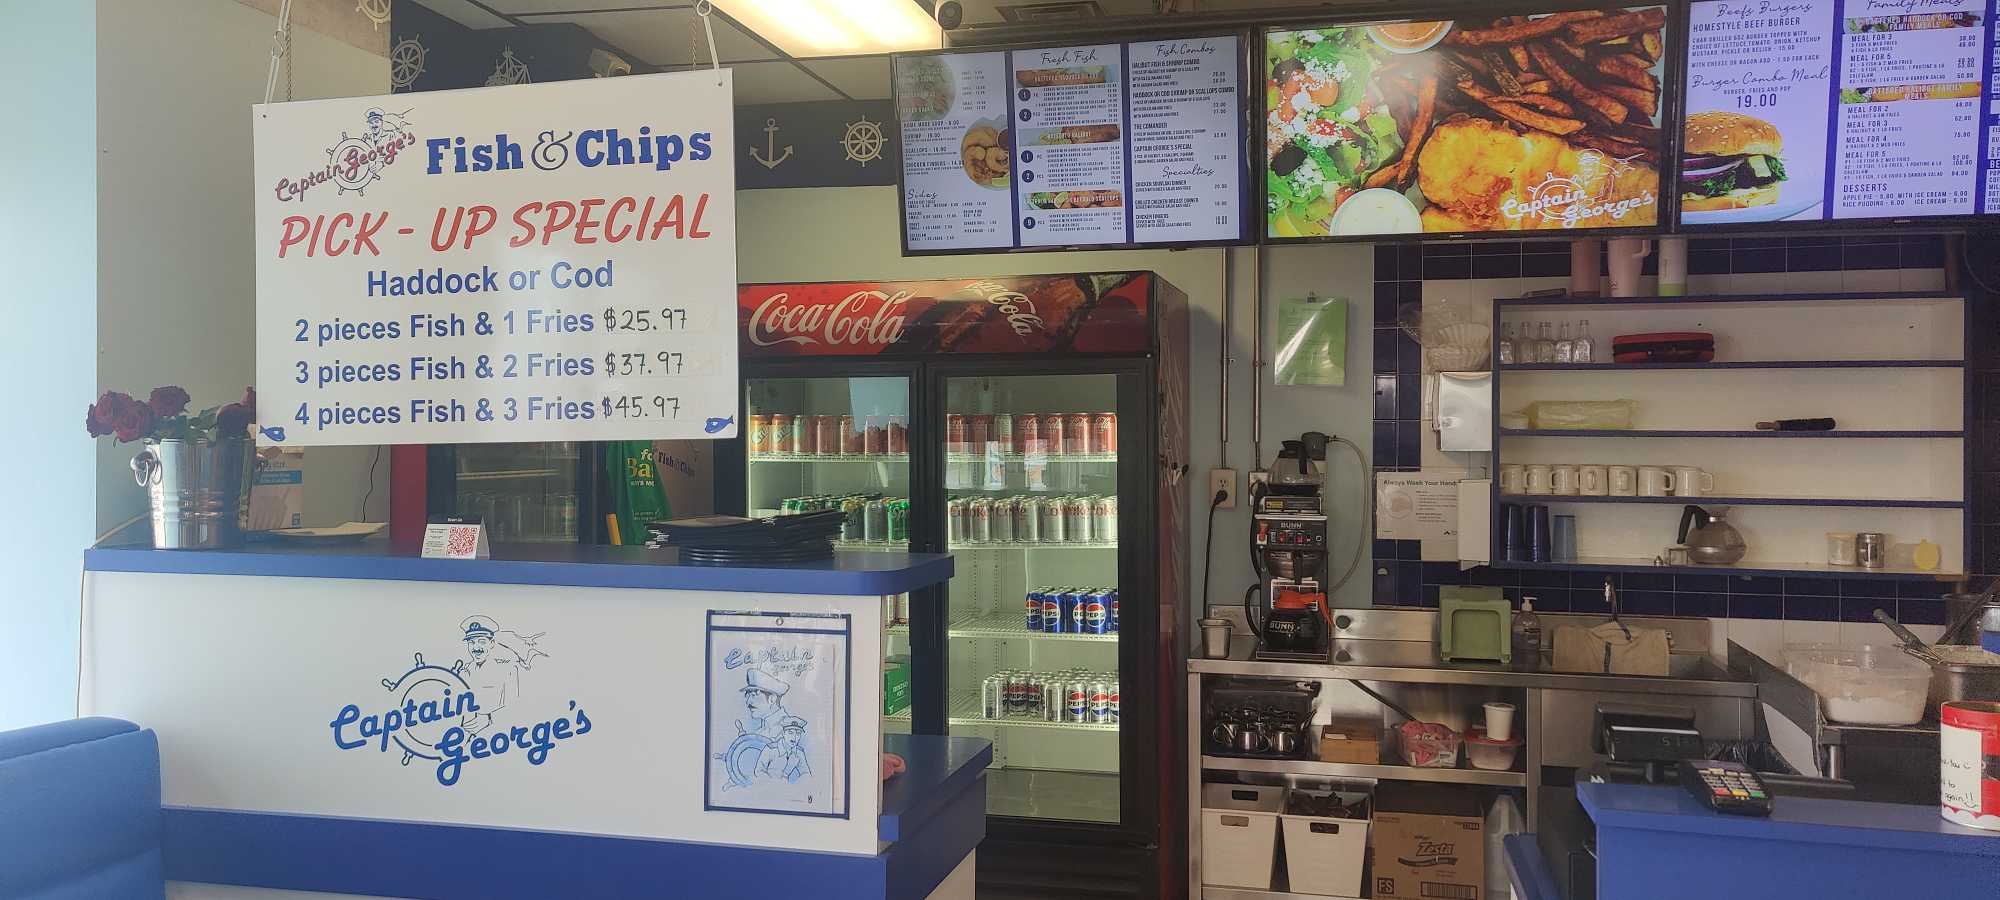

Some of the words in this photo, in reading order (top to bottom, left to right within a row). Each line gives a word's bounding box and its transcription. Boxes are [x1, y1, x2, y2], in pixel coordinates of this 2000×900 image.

[1759, 1, 1812, 17] Burgers
[1693, 21, 1741, 32] HOMESTYLE
[1745, 20, 1765, 28] BEEF
[1769, 17, 1800, 27] BURGER
[1889, 23, 1914, 31] FAMILY
[1041, 50, 1071, 65] Fresh
[1074, 49, 1097, 63] Fish
[1157, 45, 1177, 57] Fish
[1180, 43, 1215, 55] Combos
[1692, 74, 1739, 91] Burger
[1742, 70, 1787, 84] Combo
[1791, 65, 1829, 82] Meal
[1737, 93, 1777, 108] 19.00
[426, 137, 524, 175] Fish
[531, 130, 574, 171] &
[574, 126, 713, 171] Chips
[275, 162, 344, 202] Captain
[343, 130, 416, 180] George's
[1163, 164, 1215, 178] Specialties
[908, 189, 937, 199] Sides
[1842, 194, 1861, 202] APPLE
[1843, 182, 1888, 193] DESSERTS
[1502, 188, 1587, 218] Captain
[1562, 190, 1655, 228] George's
[278, 211, 389, 258] PICK
[430, 206, 497, 252] UP
[509, 193, 712, 249] SPECIAL
[367, 265, 499, 297] Haddock
[509, 269, 541, 291] or
[550, 259, 614, 289] Cod
[295, 319, 310, 343] 2
[318, 314, 401, 347] pieces
[410, 311, 466, 339] Fish
[474, 311, 495, 335] &
[503, 310, 514, 335] 1
[527, 308, 595, 334] Fries
[603, 306, 688, 334] $25.97
[295, 360, 310, 384] 3
[318, 355, 401, 388] pieces
[410, 353, 466, 380] Fish
[474, 353, 495, 379] &
[503, 352, 518, 378] 2
[527, 351, 595, 377] Fries
[604, 350, 684, 378] $37.97
[295, 401, 310, 425] 4
[318, 398, 401, 431] pieces
[410, 396, 466, 423] Fish
[474, 396, 495, 422] &
[503, 396, 518, 421] 3
[527, 395, 595, 421] Fries
[601, 395, 681, 421] $45.97
[330, 688, 480, 752] Captain
[435, 700, 592, 786] George's
[1416, 842, 1454, 857] Zesta
[1379, 880, 1393, 894] FS
